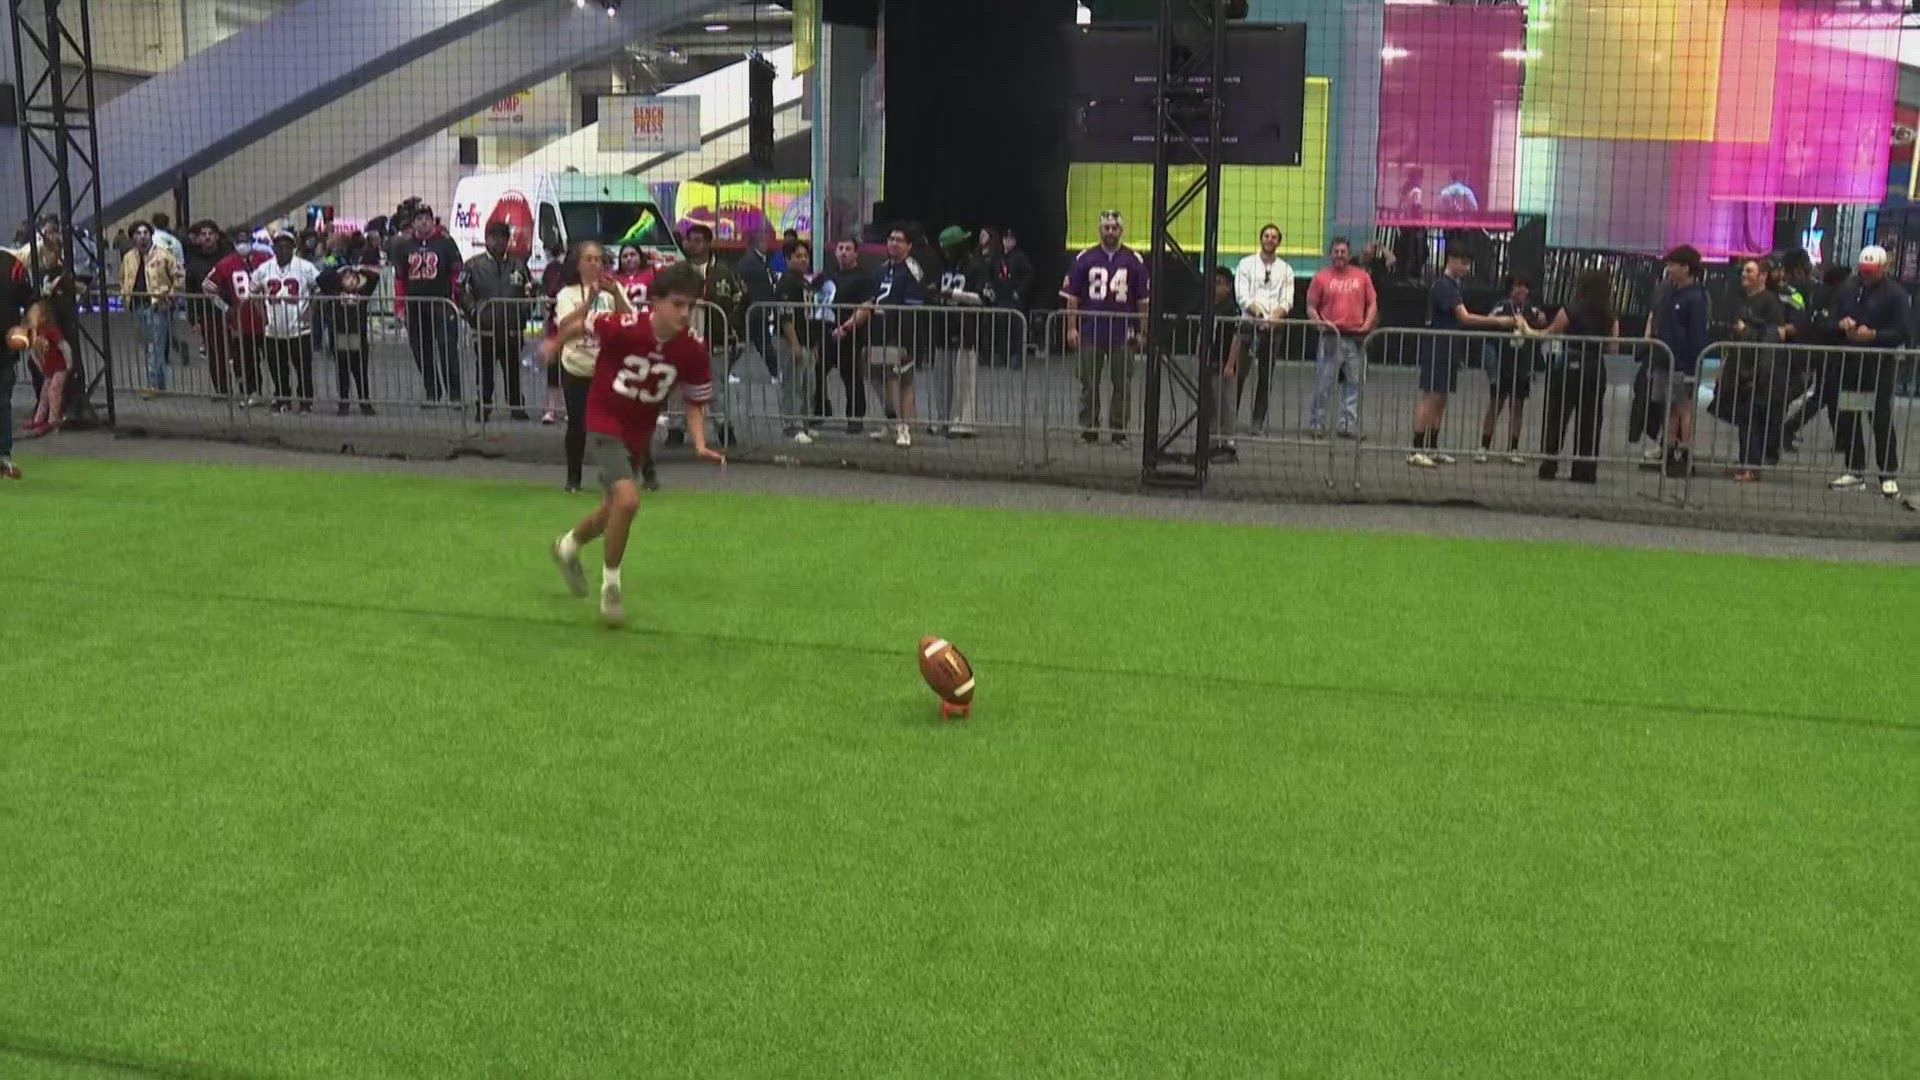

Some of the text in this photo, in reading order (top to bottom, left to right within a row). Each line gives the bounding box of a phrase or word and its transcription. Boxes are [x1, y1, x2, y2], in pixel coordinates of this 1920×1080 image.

[634, 106, 664, 119] BENCH
[634, 120, 664, 134] PRESS
[455, 203, 481, 228] FedEx
[408, 251, 439, 280] 23
[1088, 266, 1128, 302] 84
[611, 354, 678, 403] 23
